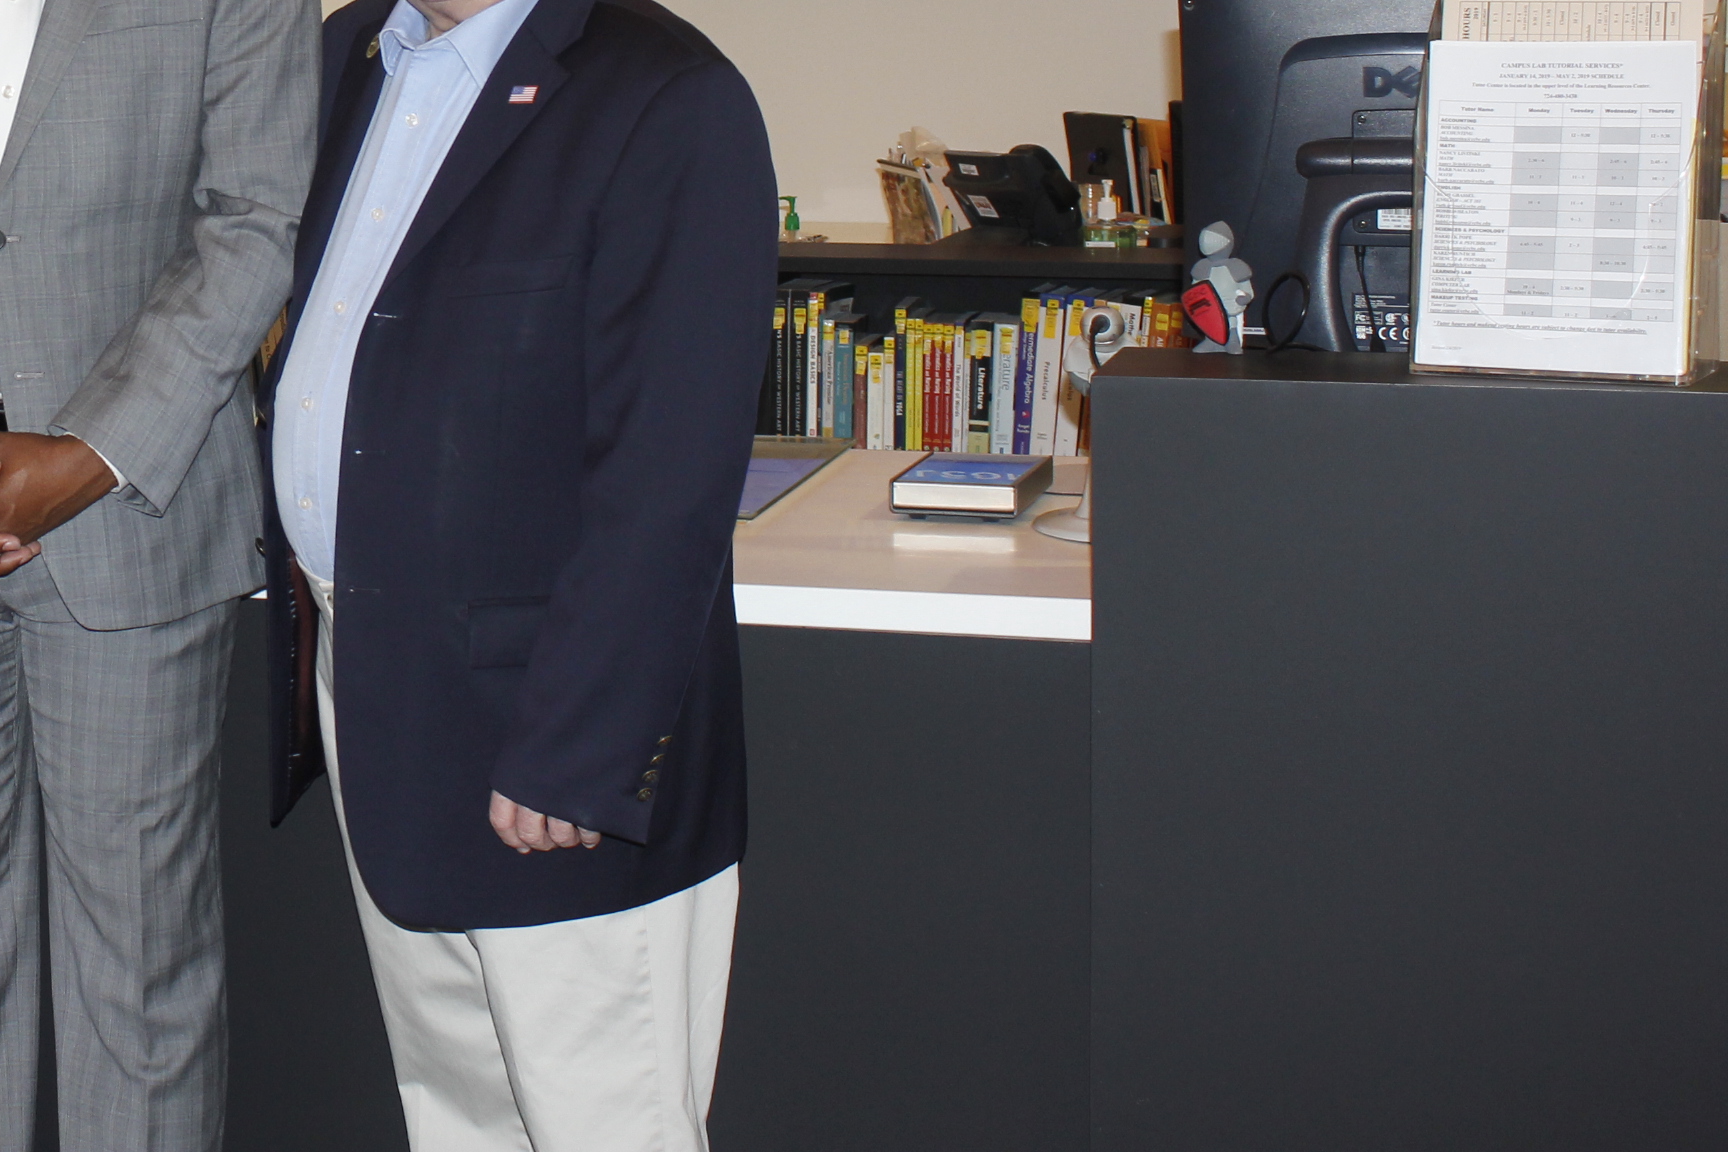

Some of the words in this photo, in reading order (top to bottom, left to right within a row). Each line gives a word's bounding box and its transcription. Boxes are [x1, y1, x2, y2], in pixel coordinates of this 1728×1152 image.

[1462, 7, 1471, 40] HOURS
[977, 367, 986, 410] Literature
[1002, 354, 1012, 391] erature
[1023, 373, 1034, 404] Algebra
[1041, 362, 1050, 401] Precalculus
